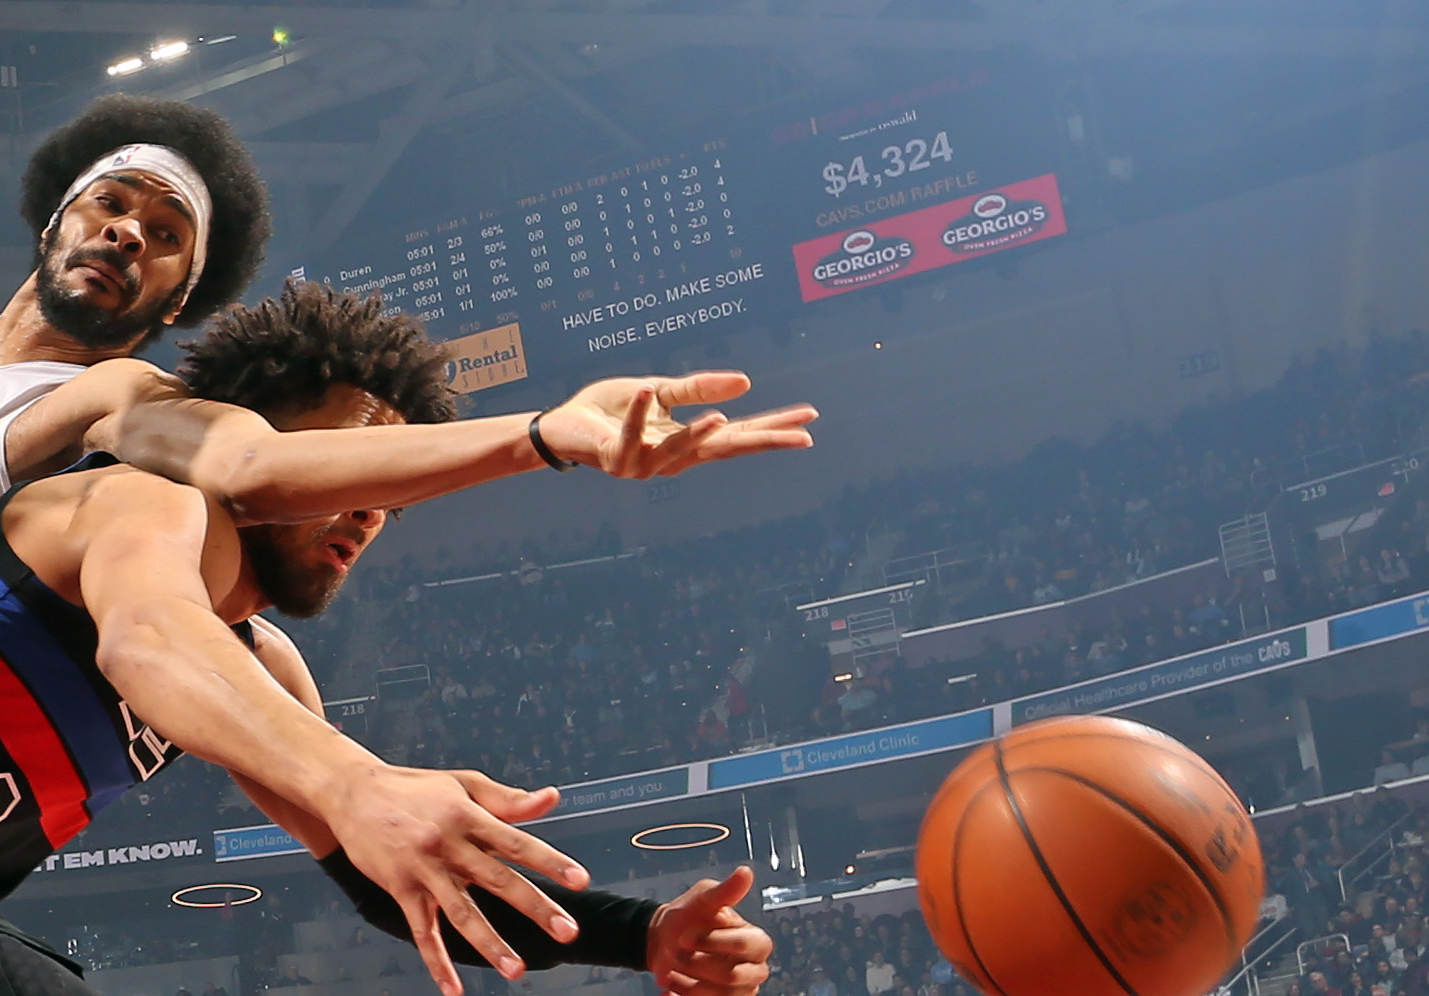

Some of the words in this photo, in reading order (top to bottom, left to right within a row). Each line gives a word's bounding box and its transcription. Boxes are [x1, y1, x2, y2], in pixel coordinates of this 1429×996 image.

[822, 131, 954, 198] $4,324
[340, 265, 372, 281] Duren
[407, 244, 435, 261] 05:01
[525, 213, 542, 226] 0/0
[561, 201, 578, 214] 0/0
[596, 194, 604, 205] 2
[620, 187, 628, 198] 0
[642, 181, 649, 191] 1
[660, 175, 669, 185] 0
[713, 159, 722, 169] 4
[343, 272, 406, 297] Cunningham
[410, 260, 437, 277] 05:01
[450, 252, 467, 266] 2/4
[483, 240, 507, 255] 50%
[528, 229, 545, 242] 0/0
[564, 217, 582, 231] 0/0
[599, 210, 607, 221] 0
[624, 203, 631, 214] 1
[643, 197, 652, 207] 0
[663, 192, 672, 202] 0
[716, 176, 724, 186] 4
[942, 206, 1046, 246] GEORGIO'S
[395, 288, 409, 300] Jr.
[412, 276, 440, 293] 05:01
[453, 268, 469, 281] 0/1
[489, 257, 507, 270] 0%
[531, 245, 547, 258] 0/1
[567, 234, 585, 247] 0/0
[603, 227, 610, 237] 1
[626, 219, 635, 230] 0
[646, 213, 655, 224] 0
[668, 207, 675, 218] 1
[719, 192, 728, 202] 0
[415, 291, 443, 308] 05:01
[455, 283, 472, 296] 0/1
[492, 273, 510, 286] 0%
[534, 260, 551, 274] 0/0
[570, 249, 588, 263] 0/0
[605, 243, 613, 253] 0
[631, 235, 638, 246] 1
[651, 229, 658, 240] 1
[670, 224, 678, 234] 0
[723, 208, 731, 218] 0
[813, 243, 913, 281] GEORGIO'S
[458, 300, 475, 312] 1/1
[490, 286, 519, 303] 100%
[537, 276, 554, 290] 0/0
[573, 265, 591, 279] 0/0
[609, 258, 616, 269] 1
[632, 251, 641, 262] 0
[653, 245, 661, 256] 0
[673, 239, 682, 250] 0
[727, 224, 735, 235] 2
[562, 307, 604, 331] HAVE
[606, 301, 630, 320] TO
[633, 292, 662, 313] DO.
[665, 277, 713, 303] MAKE
[715, 263, 765, 291] SOME
[587, 326, 643, 353] NOISE.
[645, 298, 748, 338] EVERYBODY.
[458, 345, 518, 373] Rental
[1300, 484, 1327, 503] 219
[804, 606, 829, 622] 218
[1150, 661, 1210, 688] Provider
[1212, 656, 1227, 674] of
[1230, 650, 1253, 668] the
[342, 703, 366, 717] 218
[806, 739, 876, 765] Cleveland
[878, 733, 920, 751] Clinic
[573, 792, 606, 806] team
[610, 784, 635, 800] and
[63, 851, 104, 869] EM
[108, 839, 203, 864] KNOW.
[229, 833, 293, 850] Cleveland
